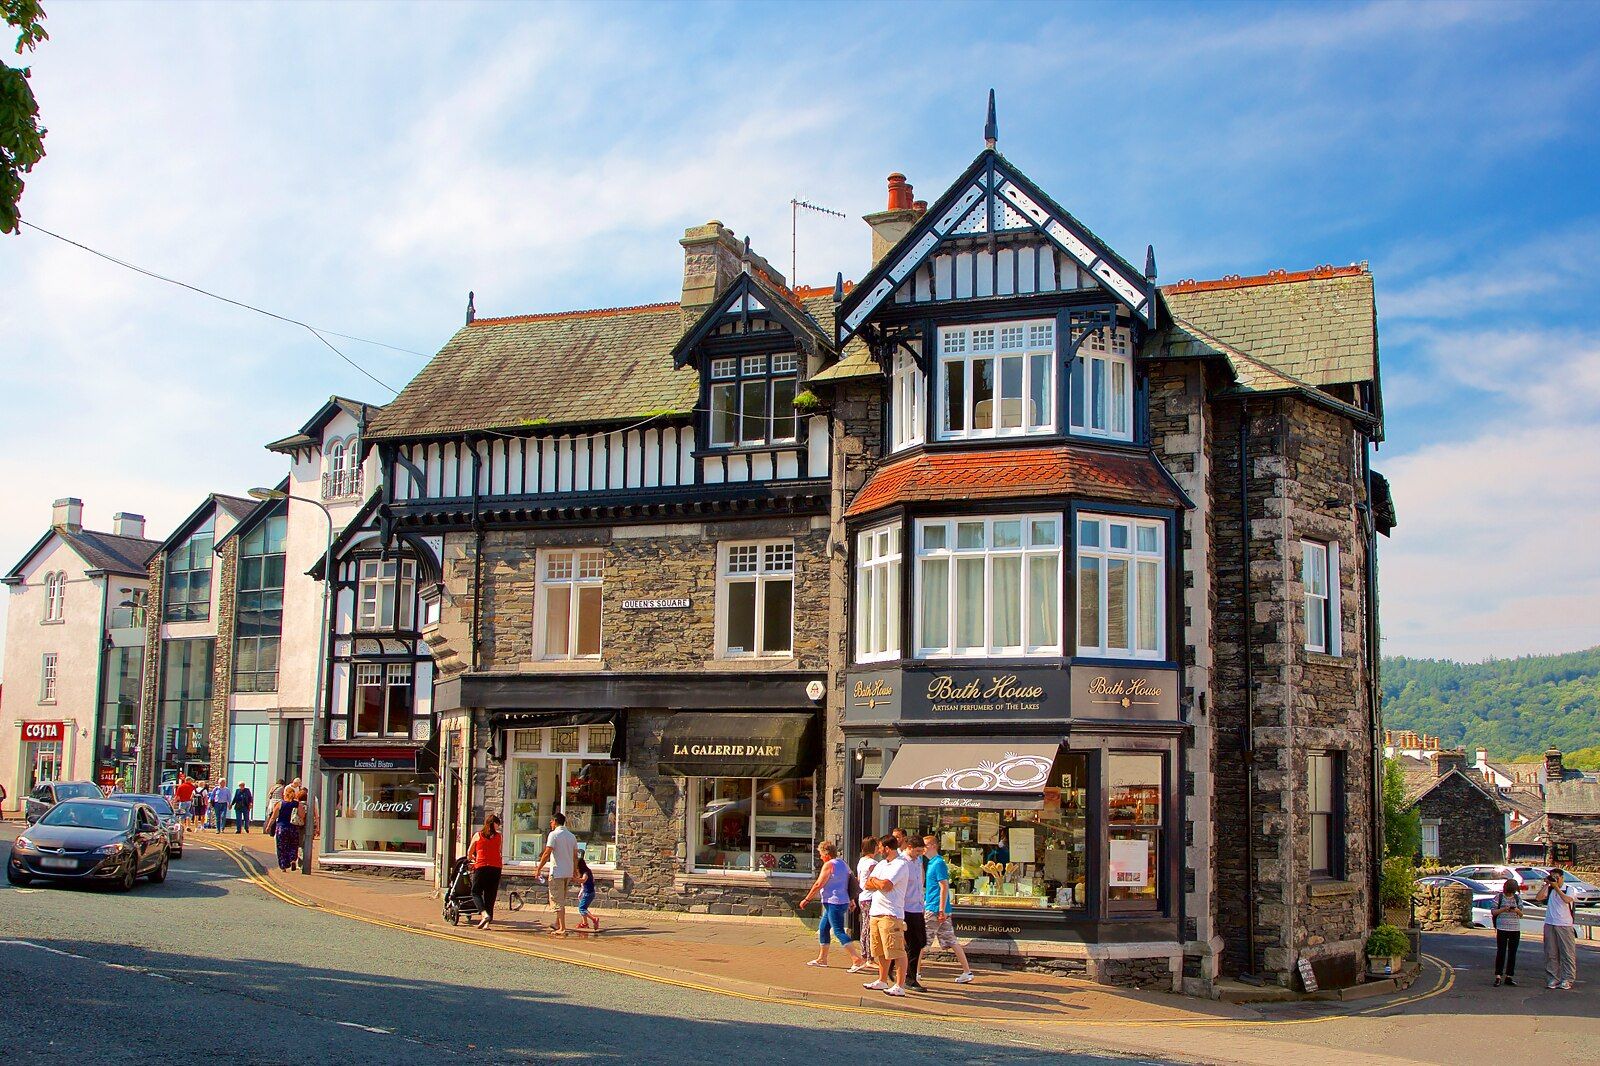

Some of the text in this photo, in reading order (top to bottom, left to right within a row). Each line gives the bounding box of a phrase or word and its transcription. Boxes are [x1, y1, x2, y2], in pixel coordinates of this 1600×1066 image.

[624, 599, 687, 608] QUEEN'S SQUARE
[926, 673, 1043, 700] Bath House
[1088, 676, 1162, 696] Bath House
[1020, 702, 1040, 710] LAKES
[26, 724, 58, 738] COSTA
[673, 744, 782, 756] LA GALERIE D'ART
[354, 759, 394, 768] Licensed Bistro
[353, 795, 413, 813] Roberto's
[940, 798, 981, 808] Bath House
[987, 924, 1021, 933] ENGLAND
